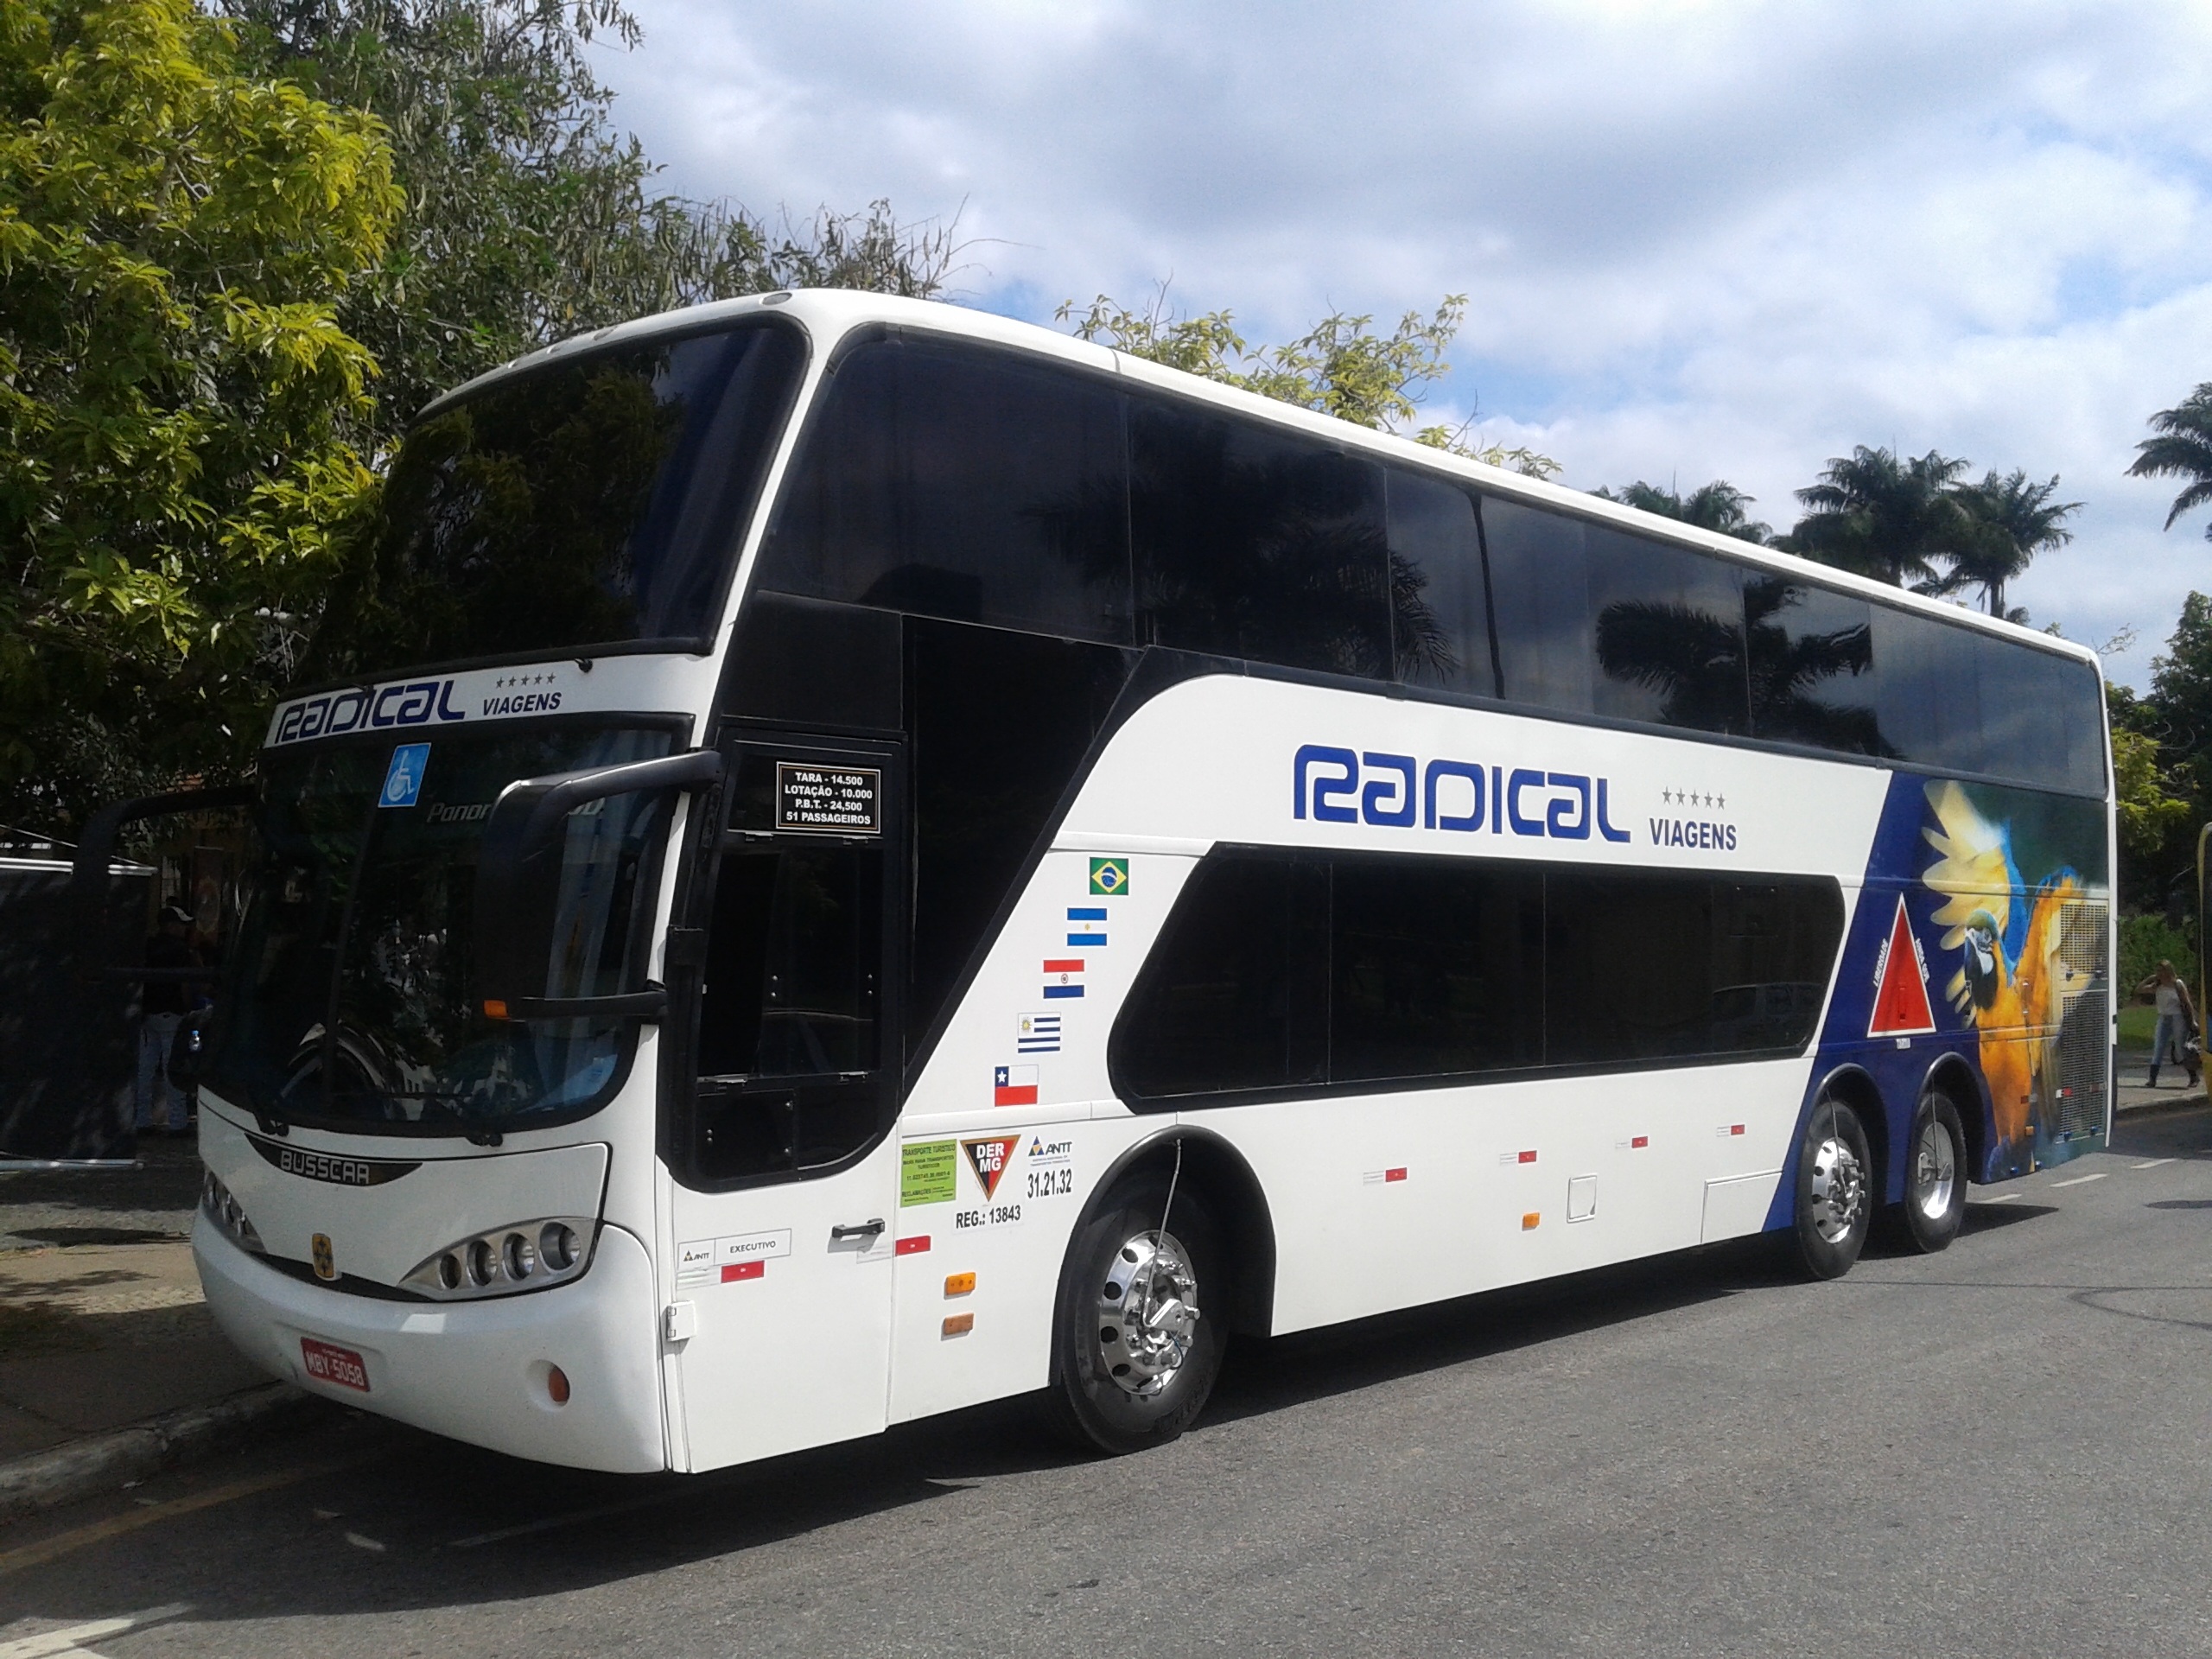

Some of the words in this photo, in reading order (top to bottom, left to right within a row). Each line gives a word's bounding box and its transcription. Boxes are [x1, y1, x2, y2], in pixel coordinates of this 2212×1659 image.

[482, 692, 562, 716] VIAGENS
[795, 772, 822, 783] TARA
[830, 775, 863, 785] 14.500
[785, 785, 833, 798] LOTAÇÃO
[841, 788, 873, 799] 10.000
[1294, 744, 1631, 843] RADICAL
[1649, 817, 1737, 851] VIAGENS
[795, 798, 822, 809] P.B.T.
[830, 801, 863, 811] 24,500
[786, 811, 798, 822] 51
[802, 812, 871, 825] PASSAGEIROS
[976, 1142, 1004, 1159] DER
[1046, 1141, 1072, 1155] ANTT
[281, 1150, 370, 1184] BUSSCAR
[979, 1158, 1001, 1173] MG
[1027, 1168, 1072, 1198] 31.21.32
[956, 1211, 986, 1230] REG.:
[989, 1205, 1021, 1224] 13843
[729, 1240, 777, 1254] EXECUTIVO
